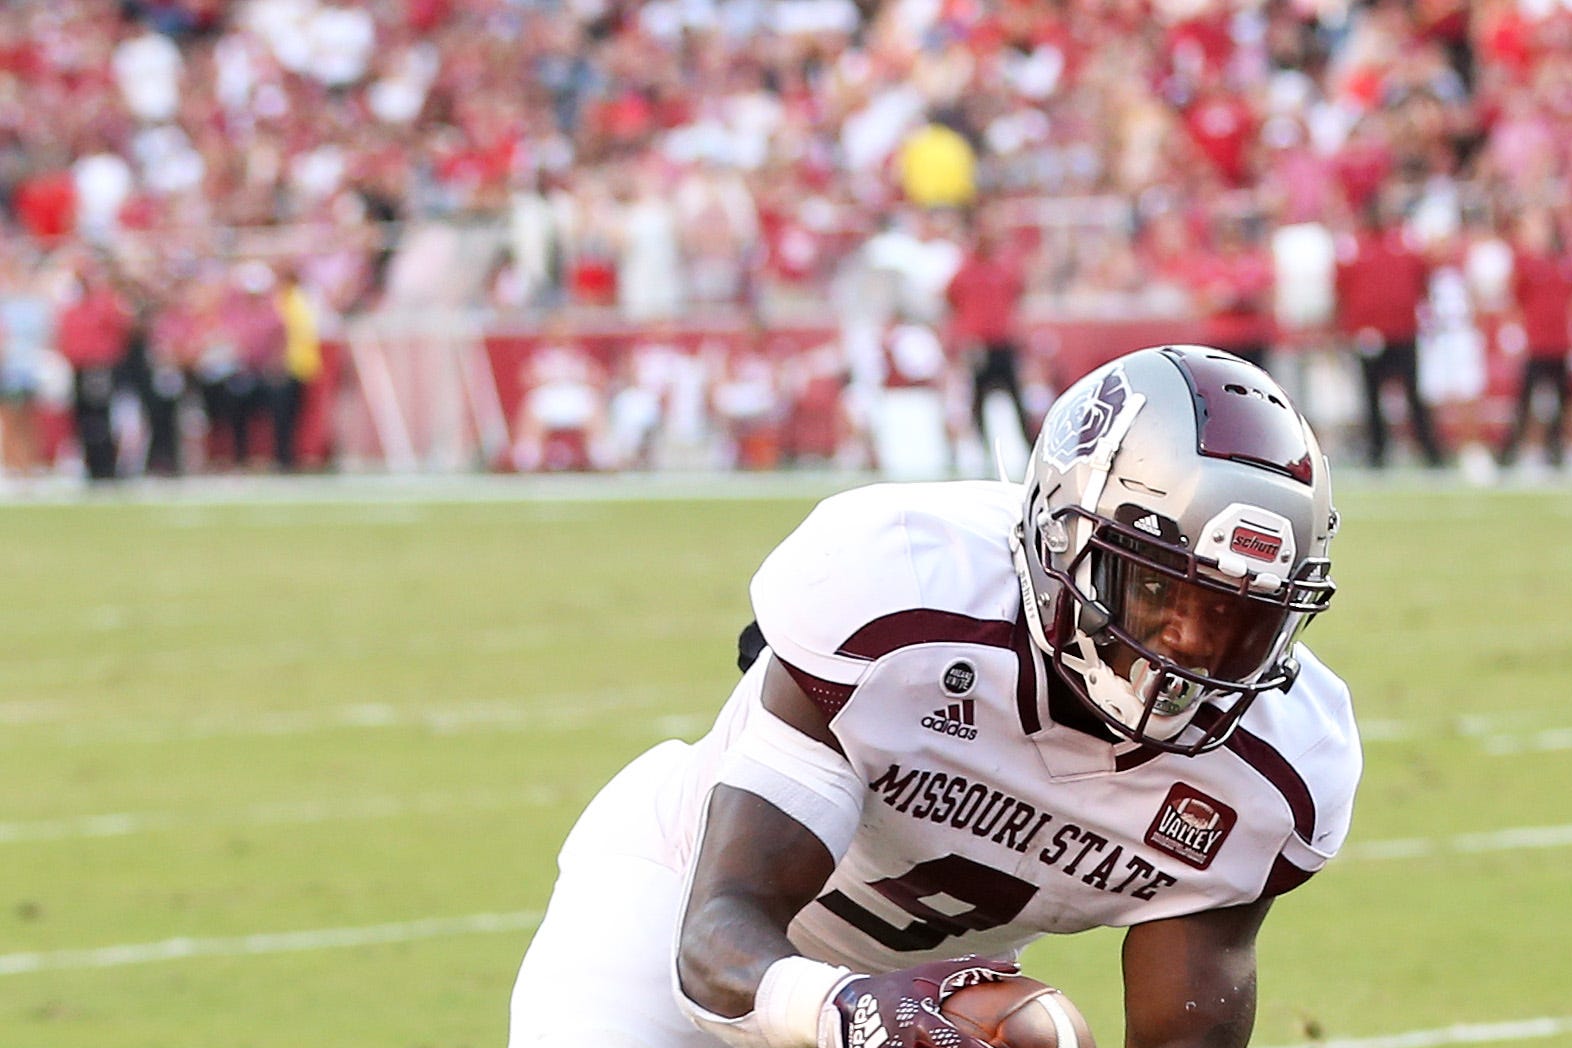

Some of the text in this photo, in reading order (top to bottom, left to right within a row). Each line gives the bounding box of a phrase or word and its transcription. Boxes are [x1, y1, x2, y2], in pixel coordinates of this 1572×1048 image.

[1233, 535, 1280, 556] schutt
[921, 716, 978, 740] adidas
[868, 764, 1052, 853] MISSOURI
[1039, 824, 1178, 901] STATE
[1158, 804, 1224, 854] VALLEY
